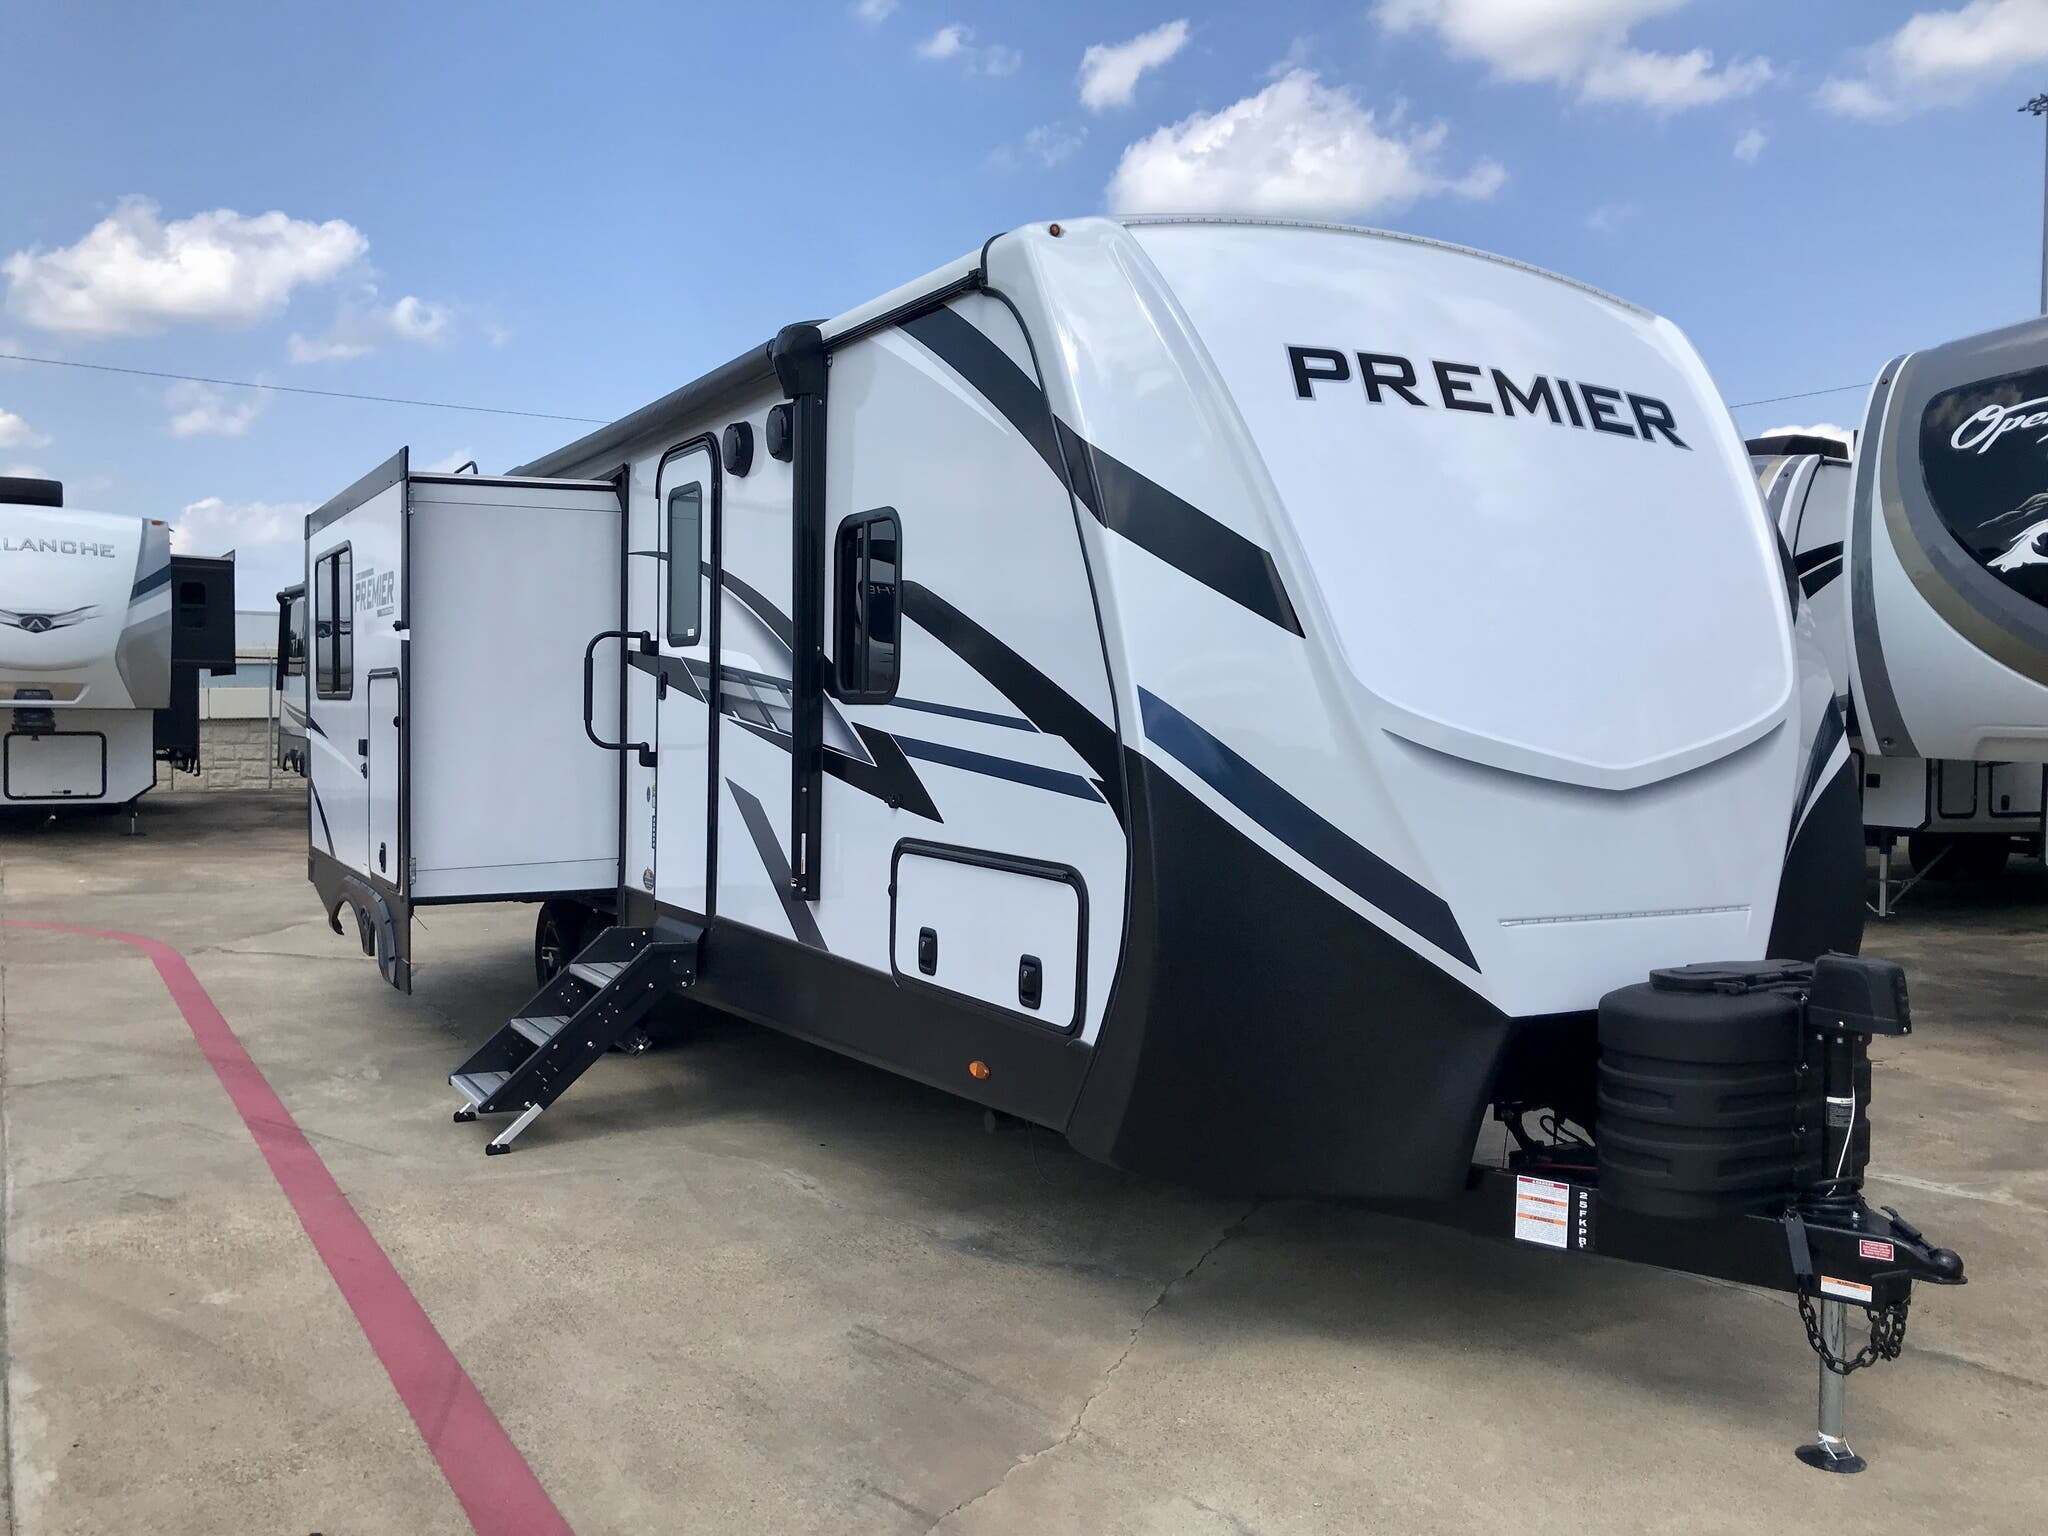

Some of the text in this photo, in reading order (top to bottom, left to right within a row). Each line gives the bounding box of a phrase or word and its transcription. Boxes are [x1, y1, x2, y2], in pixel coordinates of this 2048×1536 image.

[1284, 343, 1694, 451] PREMIER
[1951, 396, 2048, 454] Ope
[0, 537, 115, 558] LANCHE
[354, 570, 394, 612] PREMIER
